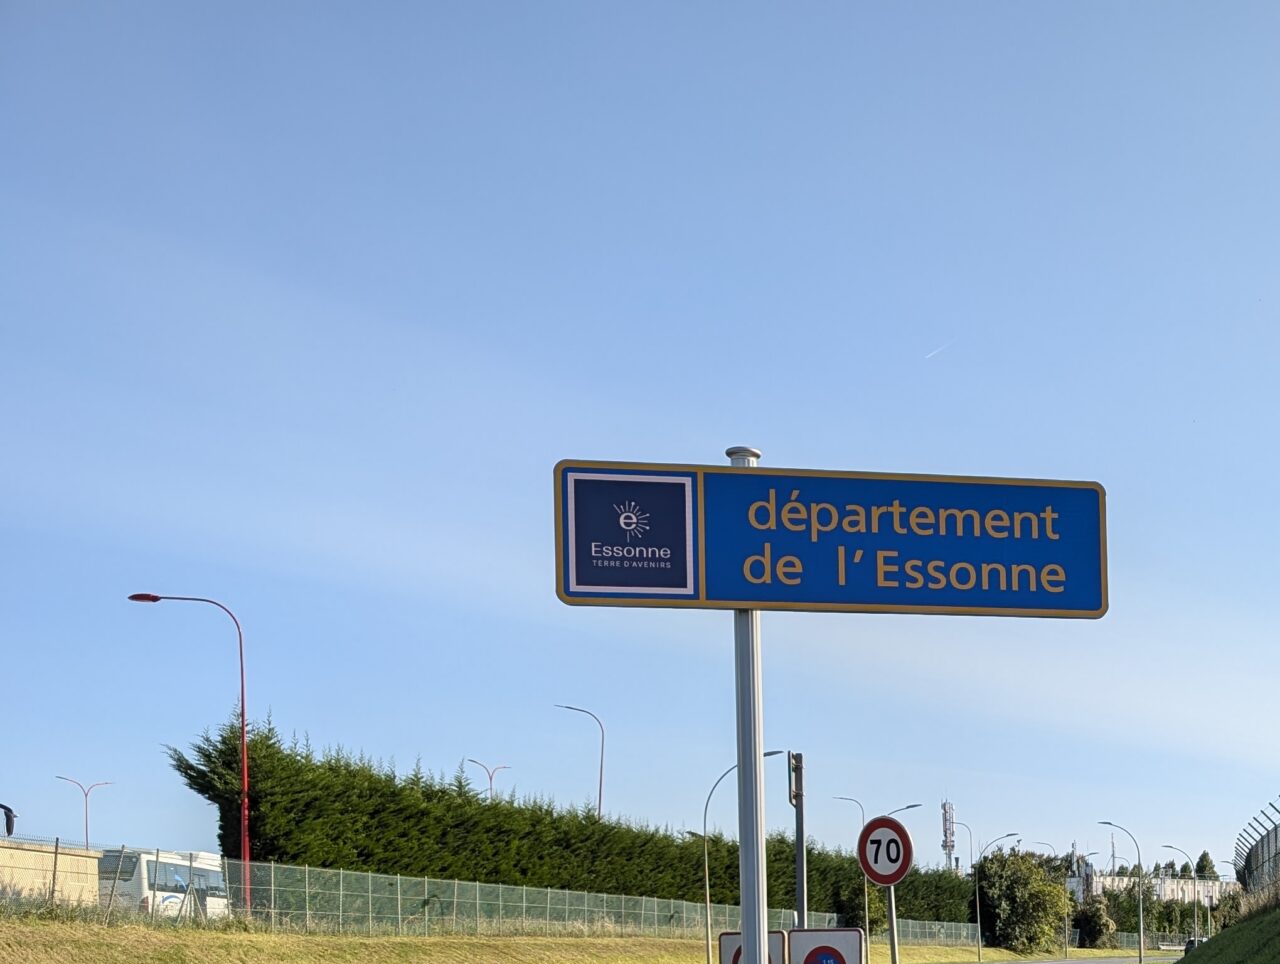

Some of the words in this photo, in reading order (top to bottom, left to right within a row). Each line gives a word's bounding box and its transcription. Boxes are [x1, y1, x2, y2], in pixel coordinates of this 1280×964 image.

[748, 489, 1059, 542] département
[592, 542, 671, 558] Essonne
[624, 560, 671, 568] D'AVENIRS
[743, 543, 803, 585] de
[870, 838, 900, 864] 70
